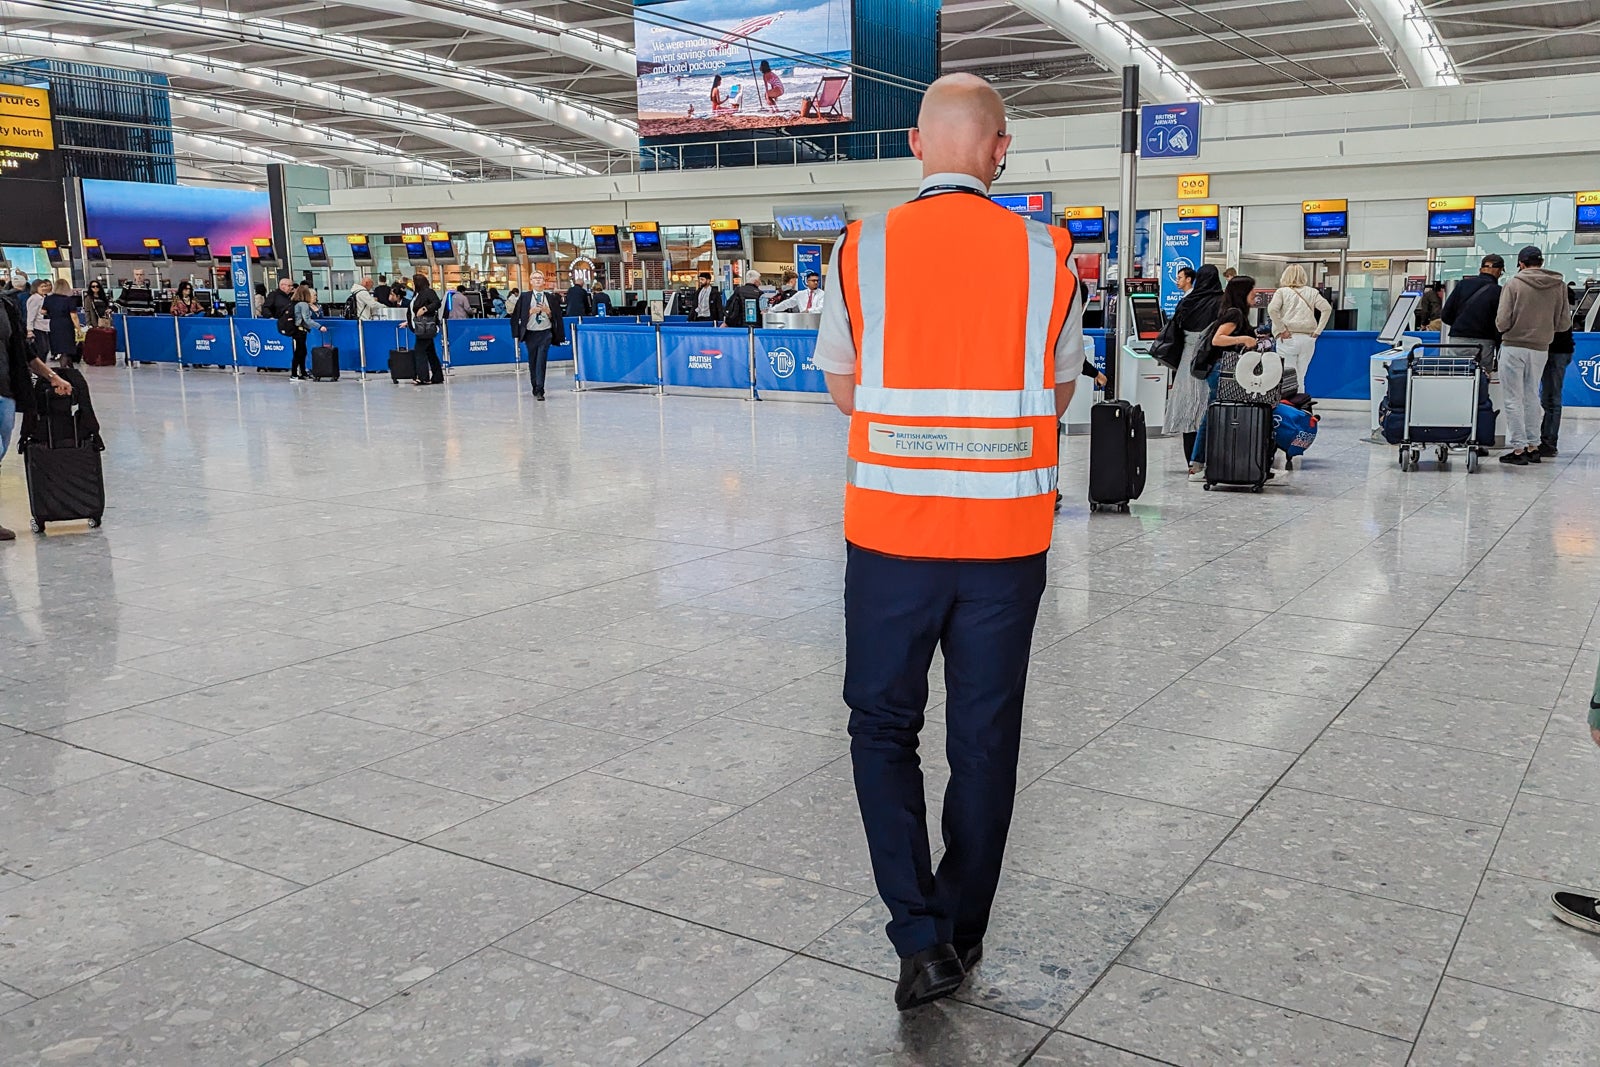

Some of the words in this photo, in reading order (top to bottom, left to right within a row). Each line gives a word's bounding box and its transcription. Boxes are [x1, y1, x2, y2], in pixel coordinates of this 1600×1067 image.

[652, 41, 665, 51] We
[667, 41, 684, 50] were
[686, 37, 707, 49] made
[652, 52, 675, 63] invent
[676, 49, 706, 61] savings
[708, 48, 717, 57] on
[719, 45, 740, 58] flight
[653, 64, 668, 75] and
[669, 62, 688, 73] hotel
[689, 59, 726, 74] packages
[13, 126, 44, 138] North
[1157, 130, 1163, 150] 1
[5, 150, 39, 160] Security?
[775, 215, 846, 231] WHSmith
[769, 357, 775, 365] 2
[802, 363, 815, 371] BAG
[1581, 366, 1588, 376] 2
[895, 439, 933, 450] FLYING
[937, 441, 964, 451] WITH
[966, 441, 1028, 452] CONFIDENCE
